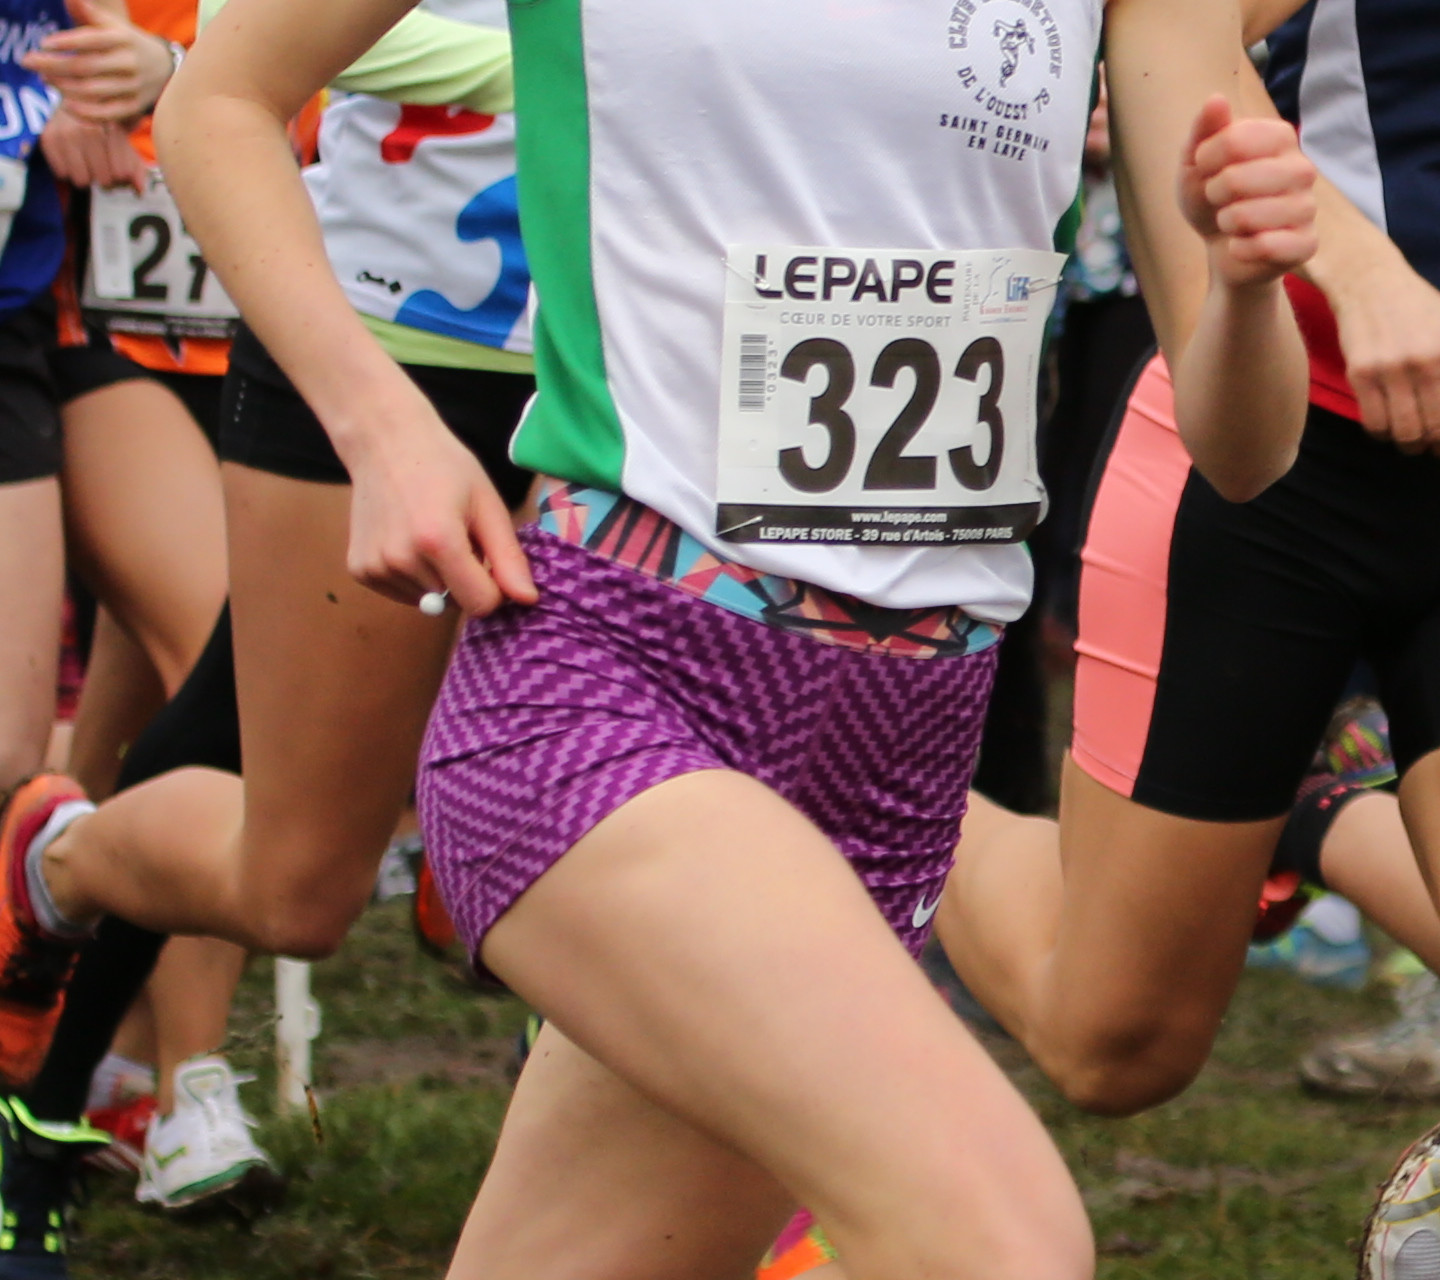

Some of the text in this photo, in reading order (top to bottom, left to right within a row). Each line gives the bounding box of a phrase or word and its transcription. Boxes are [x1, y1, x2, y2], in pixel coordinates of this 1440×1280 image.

[957, 65, 1028, 120] DE L'OUEST
[939, 113, 988, 135] SAINT
[967, 134, 1026, 161] EN LAYE
[754, 254, 956, 304] LEPAPE
[779, 311, 952, 328] CŒUR DE VOTRE SPORT
[777, 336, 1006, 494] 323
[851, 510, 947, 526] www.lepape.com
[759, 527, 809, 540] LEPAPE
[811, 528, 854, 541] STORE
[861, 528, 879, 541] 39
[880, 530, 901, 542] rue
[902, 528, 945, 542] d'Artois
[985, 526, 1014, 540] PARIS
